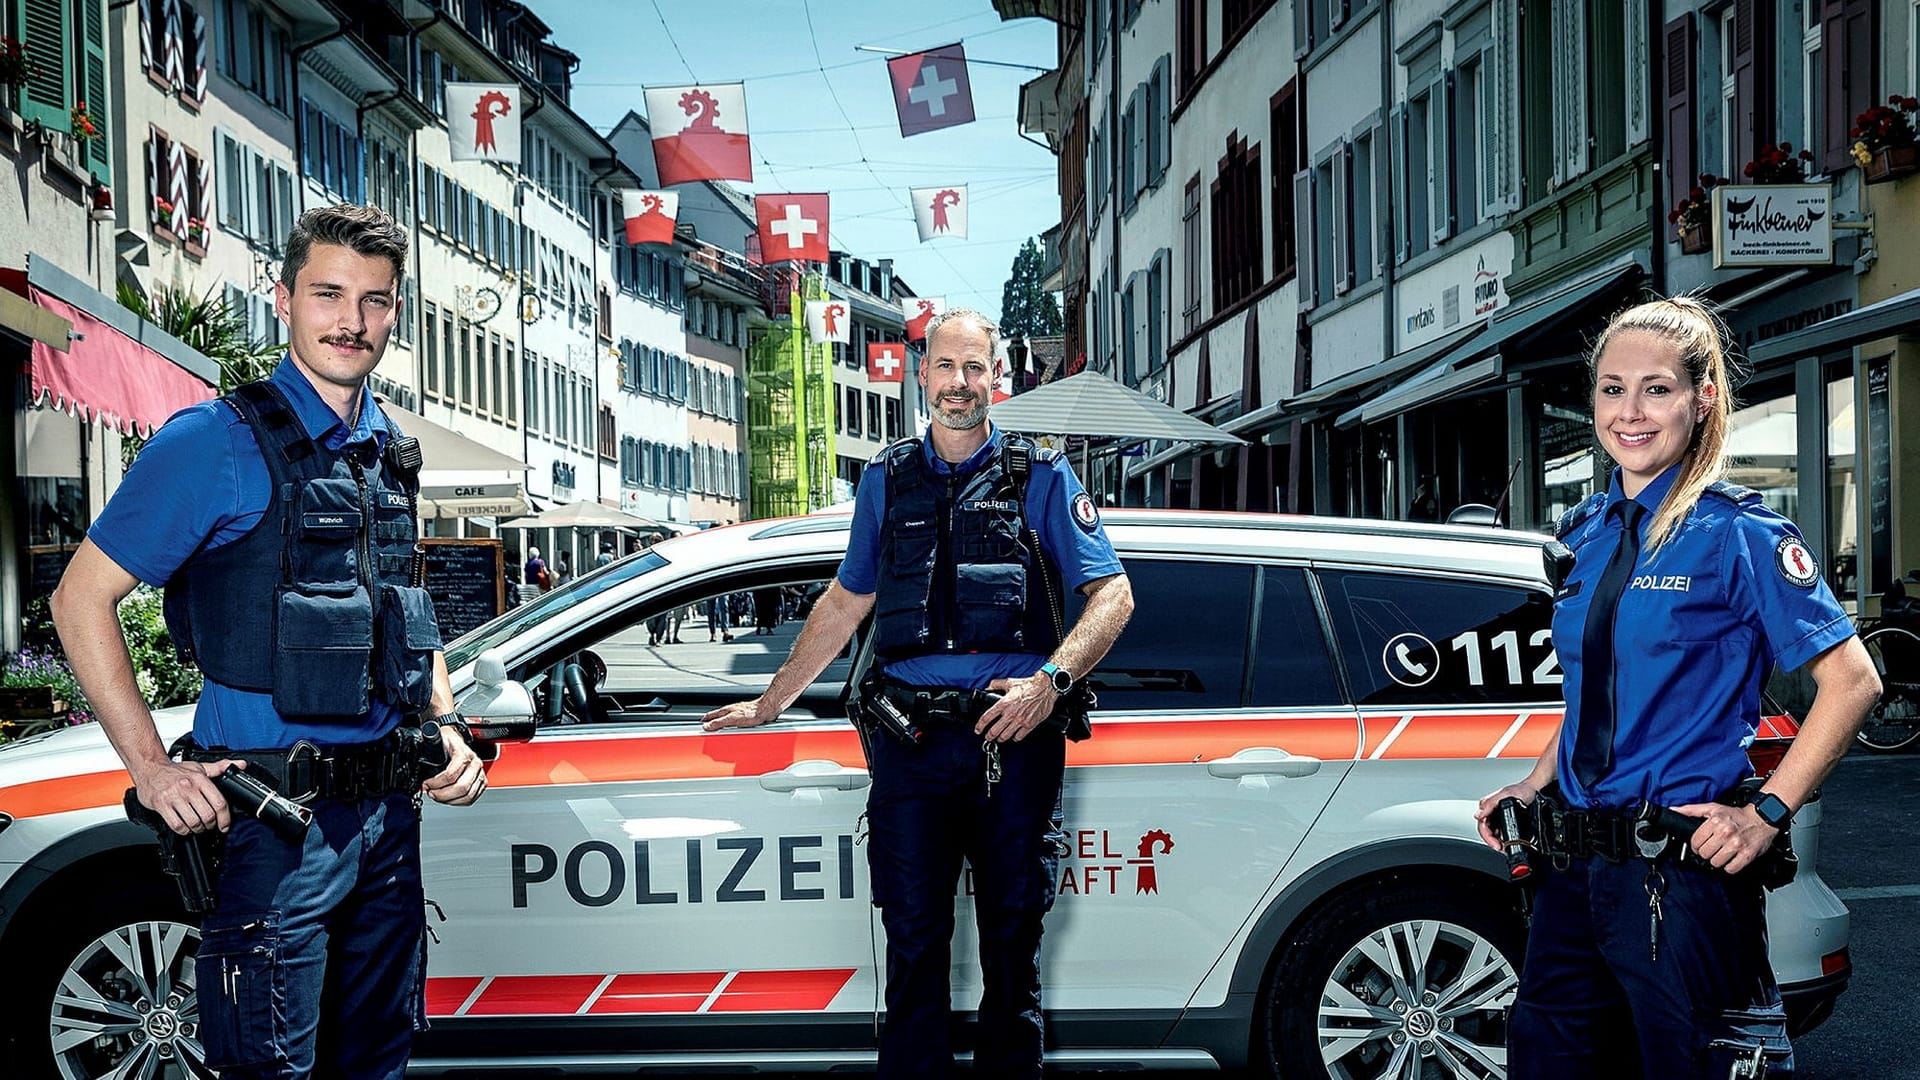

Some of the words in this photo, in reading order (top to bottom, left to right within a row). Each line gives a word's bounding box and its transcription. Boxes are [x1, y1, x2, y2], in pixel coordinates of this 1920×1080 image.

[1727, 195, 1825, 240] Finkbeiner
[455, 487, 485, 497] CAFE
[974, 500, 1009, 509] POLIZEI
[1630, 575, 1691, 592] POLIZEI
[1452, 629, 1564, 685] 112
[1058, 830, 1122, 859] SEL
[511, 835, 855, 908] POLIZEI
